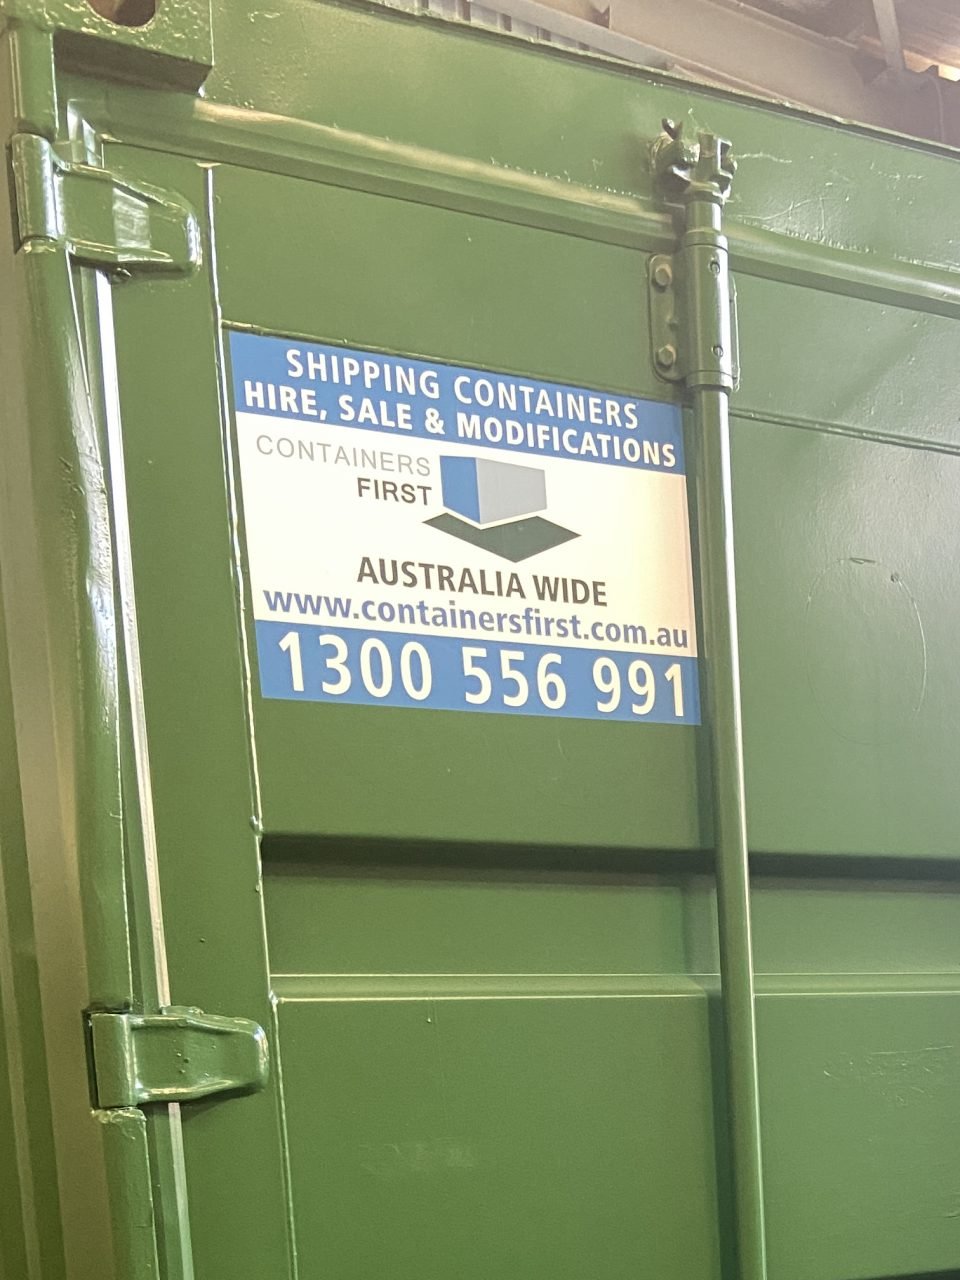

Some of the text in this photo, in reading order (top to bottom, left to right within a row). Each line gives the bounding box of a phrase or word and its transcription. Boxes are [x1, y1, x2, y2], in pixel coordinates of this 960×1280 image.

[286, 348, 640, 430] SHIPPING CONTAINERS
[243, 379, 677, 468] HIRE, SALE & MODIFICATIONS
[255, 434, 432, 477] CONTAINERS
[356, 477, 433, 506] FIRST
[356, 556, 608, 607] AUSTRALIA WIDE
[263, 589, 688, 649] www.containersfirst.com.au
[278, 631, 685, 717] 1300 556 991
